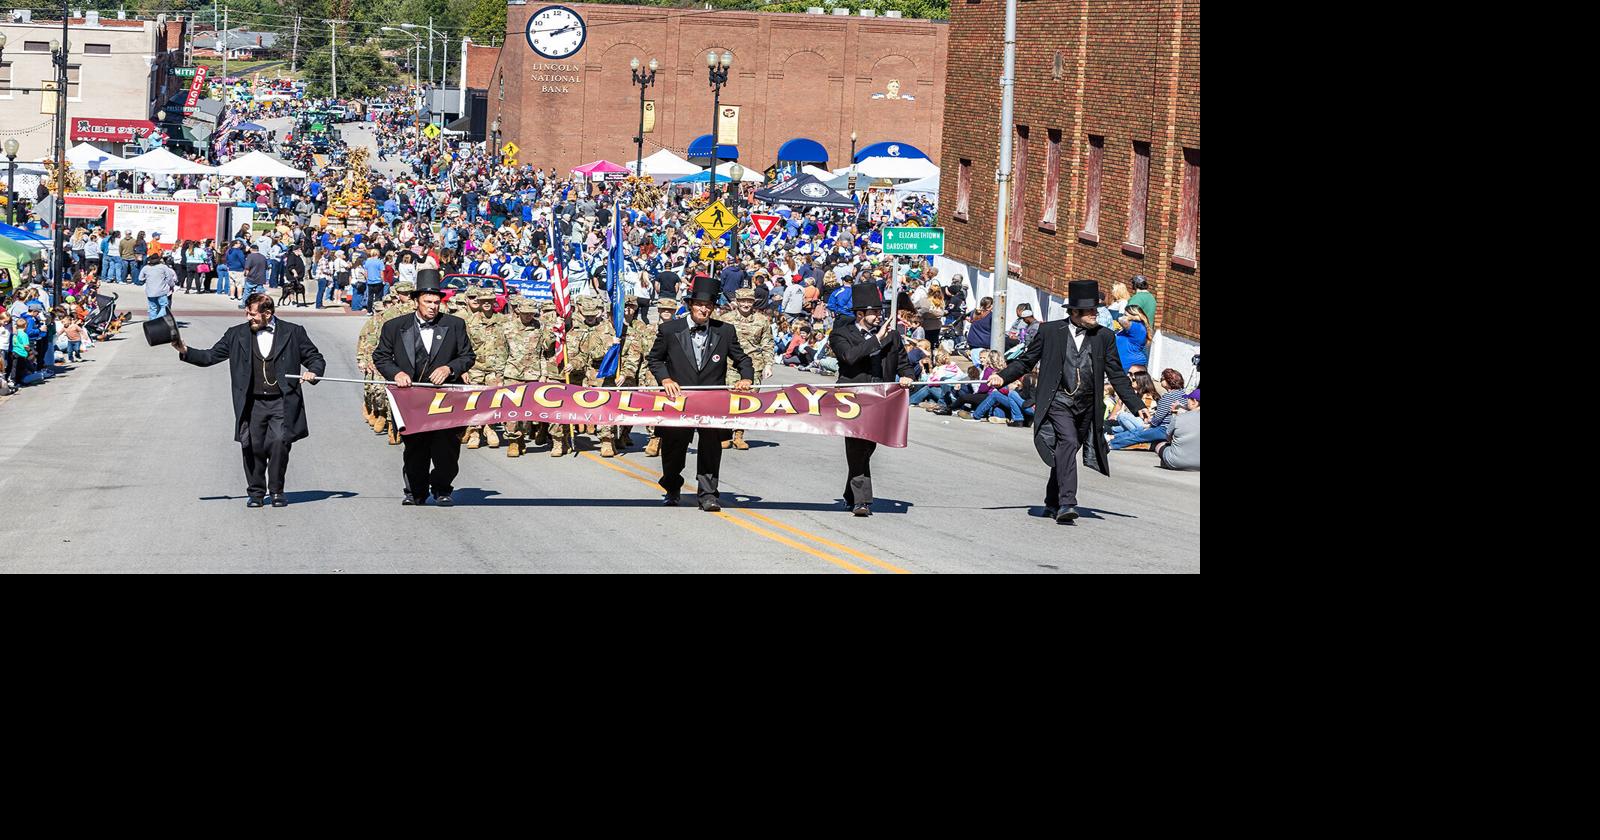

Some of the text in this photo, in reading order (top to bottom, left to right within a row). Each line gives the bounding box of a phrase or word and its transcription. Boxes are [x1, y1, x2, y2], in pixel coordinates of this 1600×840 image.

[169, 68, 196, 76] SMITH
[533, 63, 579, 72] LINCOLN
[531, 74, 581, 83] NATIONAL
[187, 67, 206, 106] DRUGS
[542, 85, 569, 94] BANK
[886, 242, 918, 250] BARDSTOWN
[428, 384, 862, 420] LINCOLN DAYS
